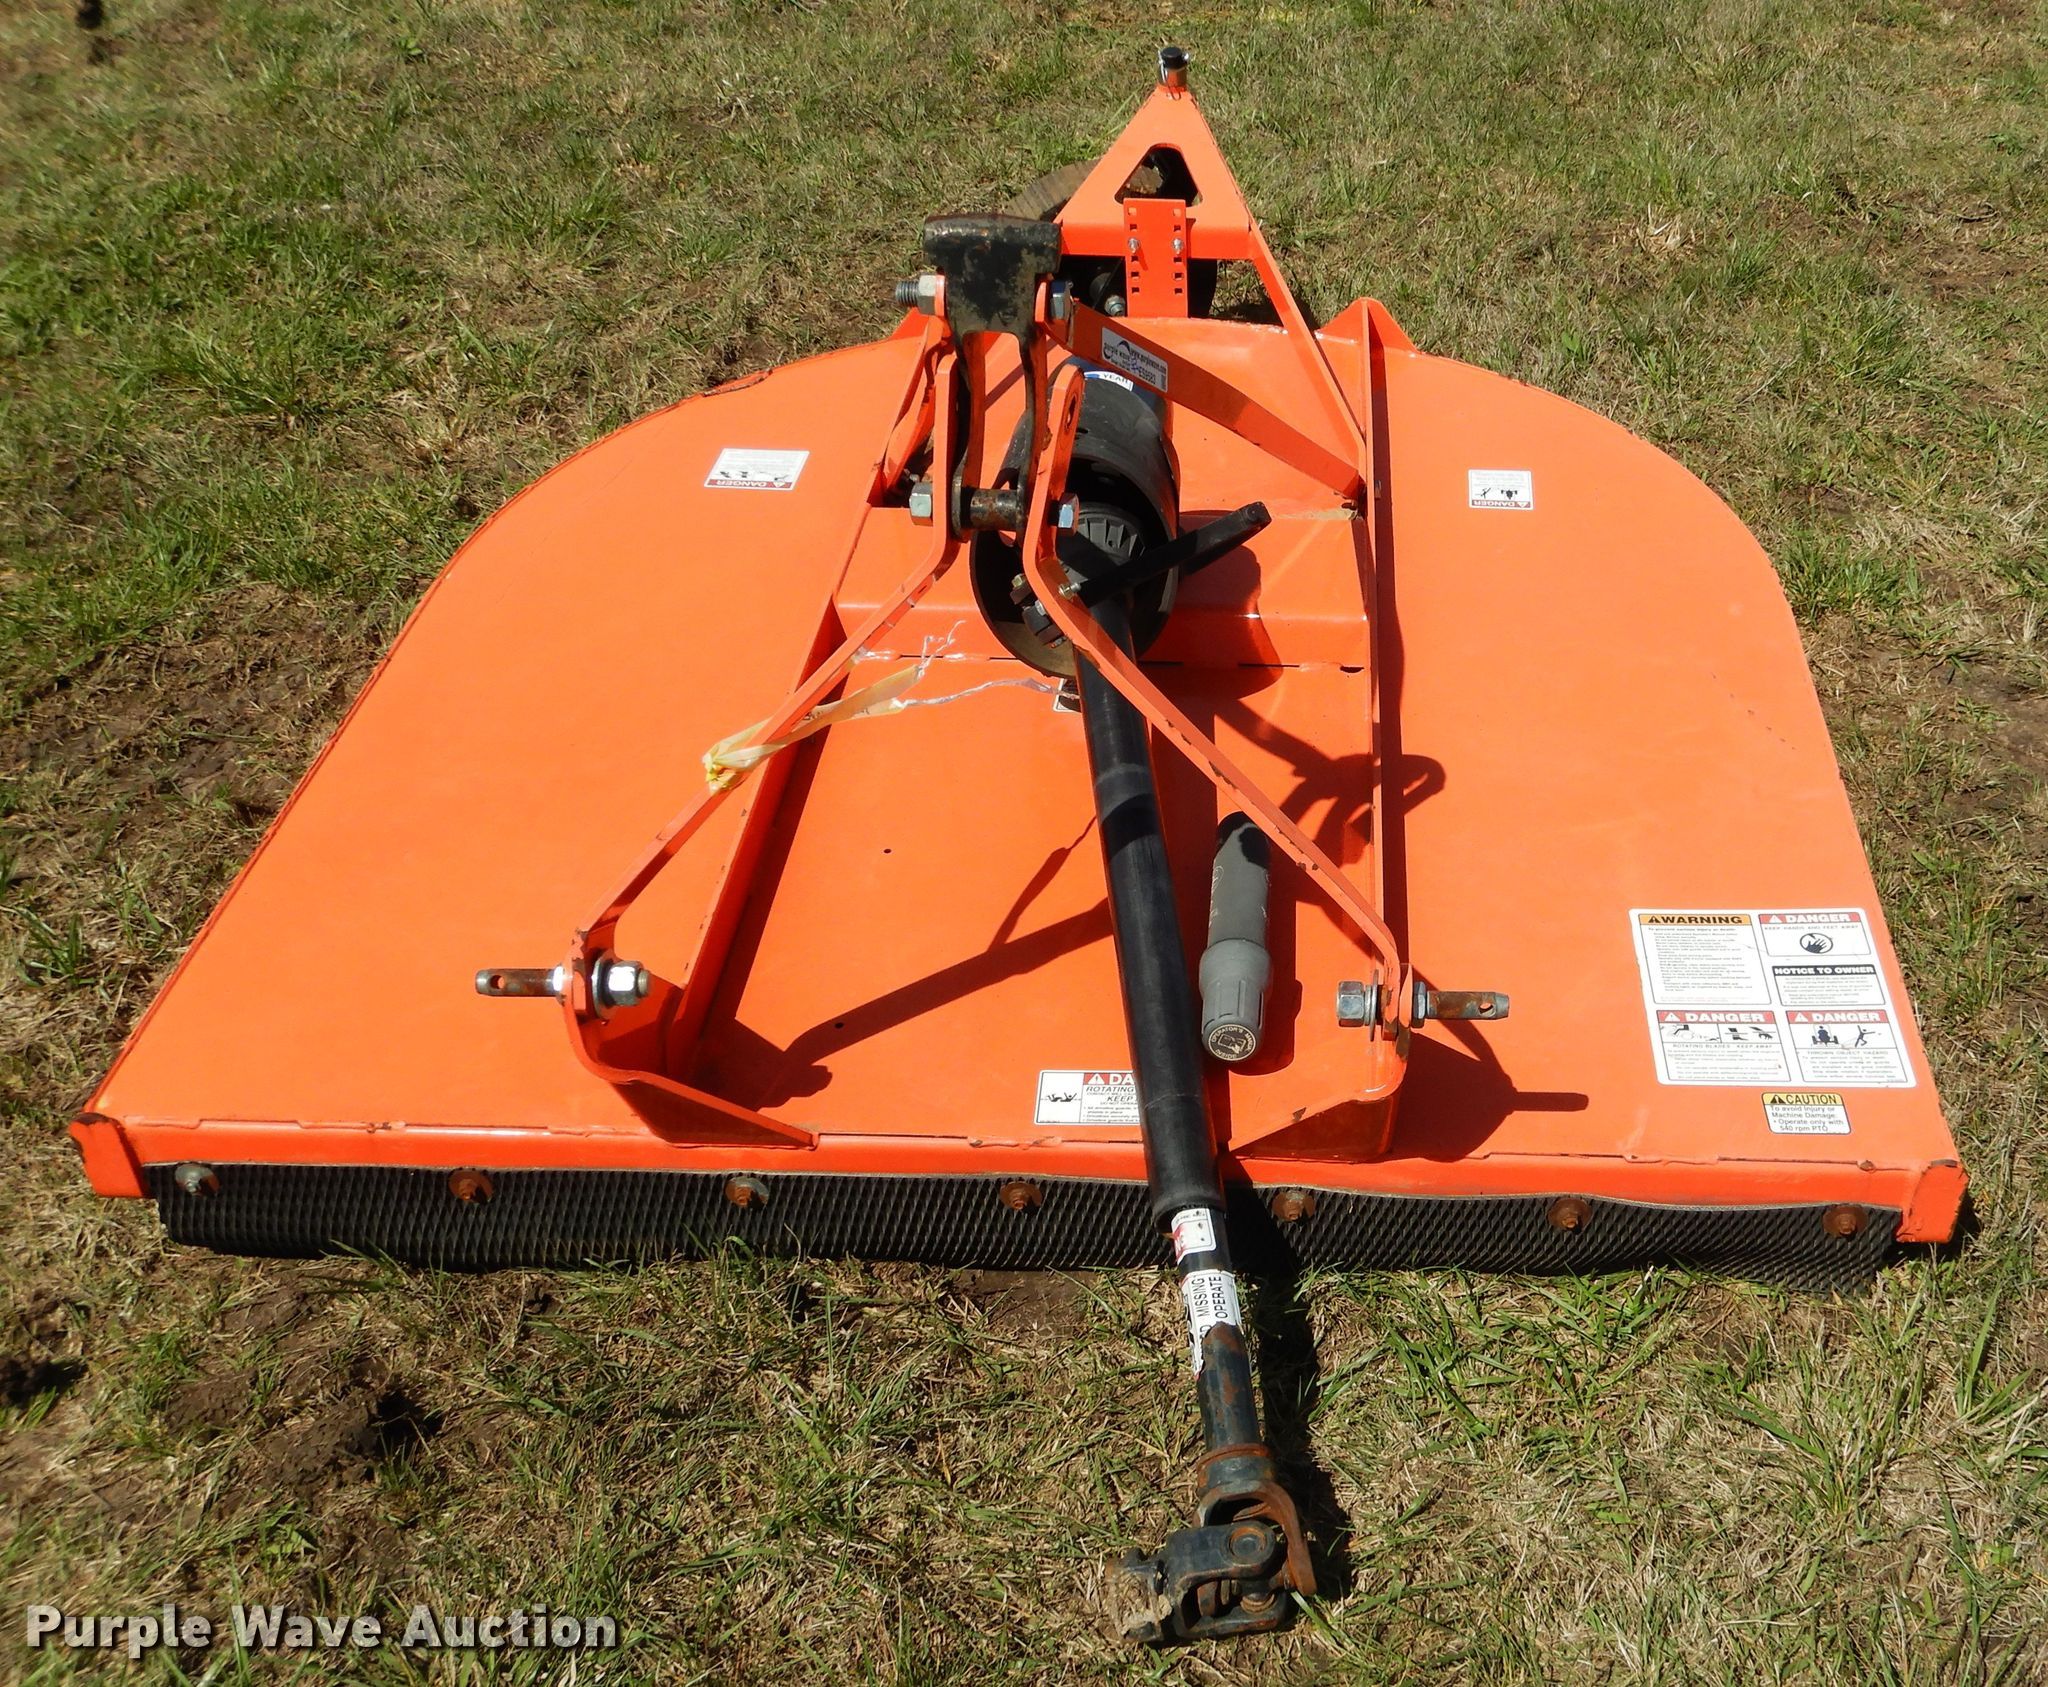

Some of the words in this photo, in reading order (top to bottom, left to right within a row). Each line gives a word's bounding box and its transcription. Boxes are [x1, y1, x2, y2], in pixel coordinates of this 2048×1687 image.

[1661, 916, 1743, 924] WARNING
[1786, 913, 1851, 923] DANGER
[1774, 967, 1815, 975] NOTICE
[1836, 966, 1874, 974] OWNER
[1685, 1013, 1766, 1022] DANGER
[1811, 1012, 1881, 1021] DANGER
[1785, 1095, 1837, 1104] CAUTION
[1191, 1277, 1210, 1318] MISSING
[1209, 1276, 1228, 1319] OPERATE
